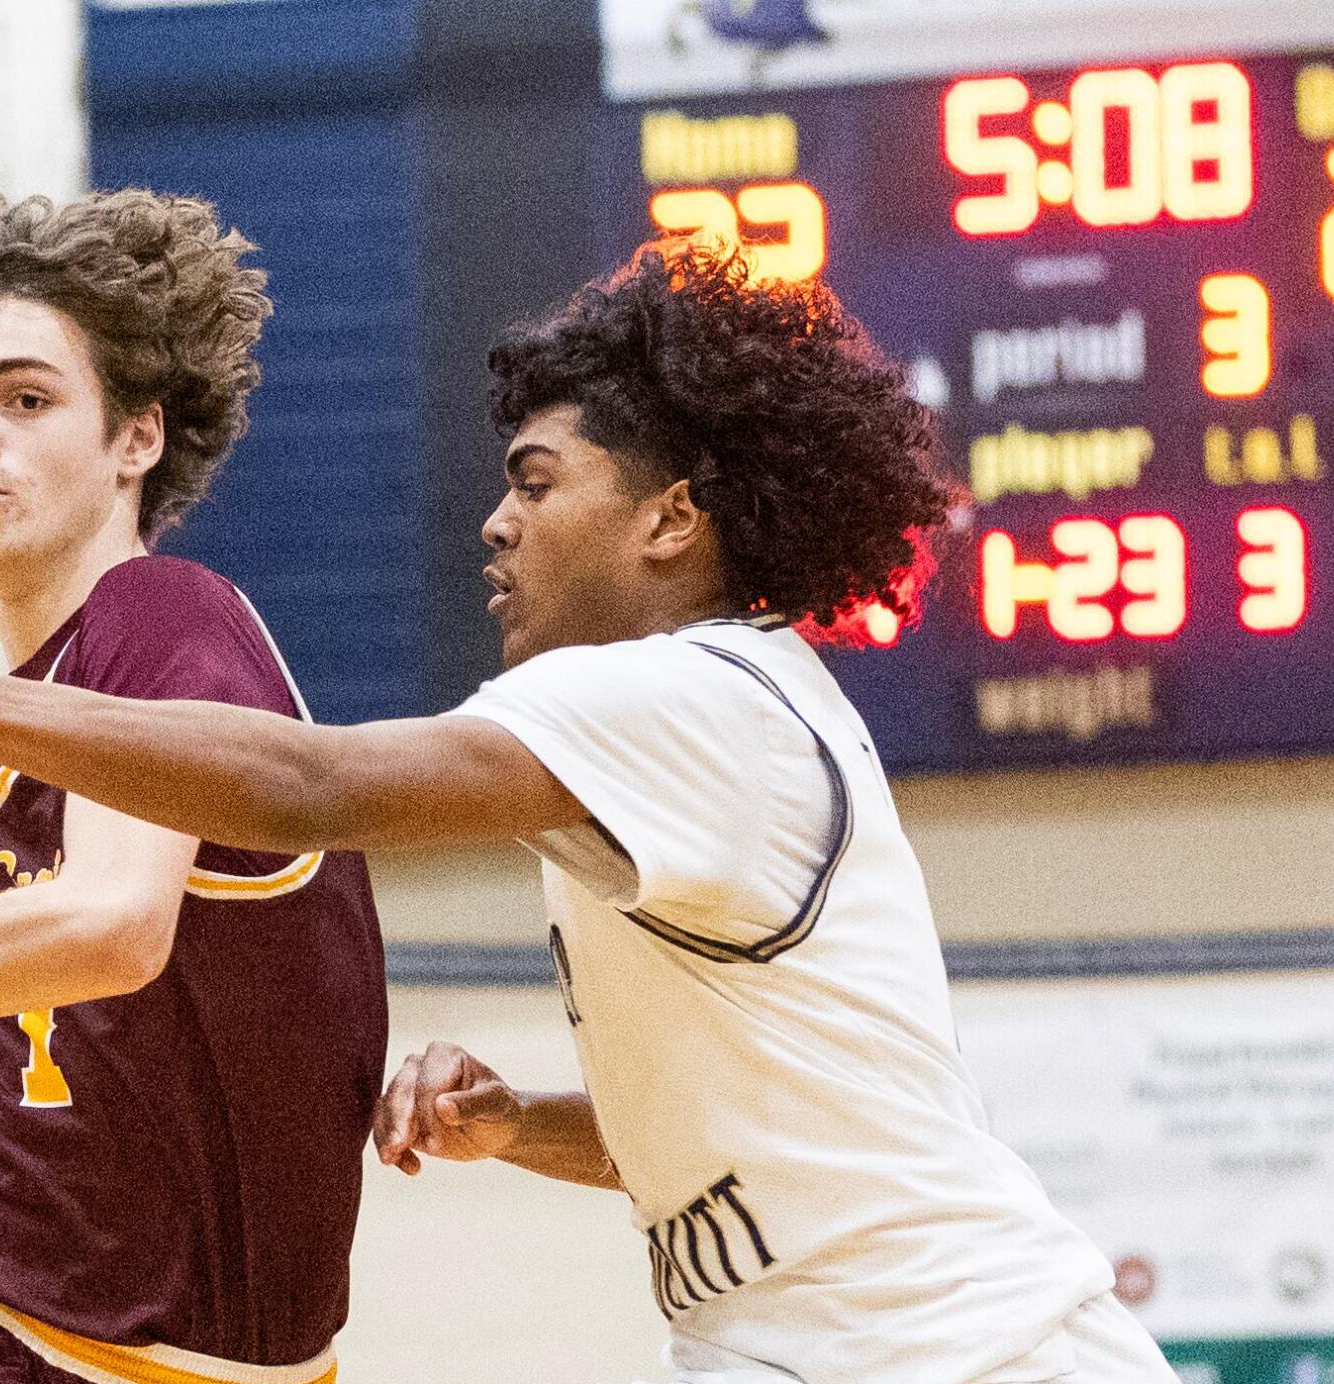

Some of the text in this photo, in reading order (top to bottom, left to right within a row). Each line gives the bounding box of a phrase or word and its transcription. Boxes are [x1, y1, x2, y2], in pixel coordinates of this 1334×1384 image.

[943, 62, 1253, 236] 5:08
[970, 311, 1146, 400] period
[1200, 274, 1271, 397] 3
[969, 427, 1154, 503] player
[1237, 507, 1305, 631] 3
